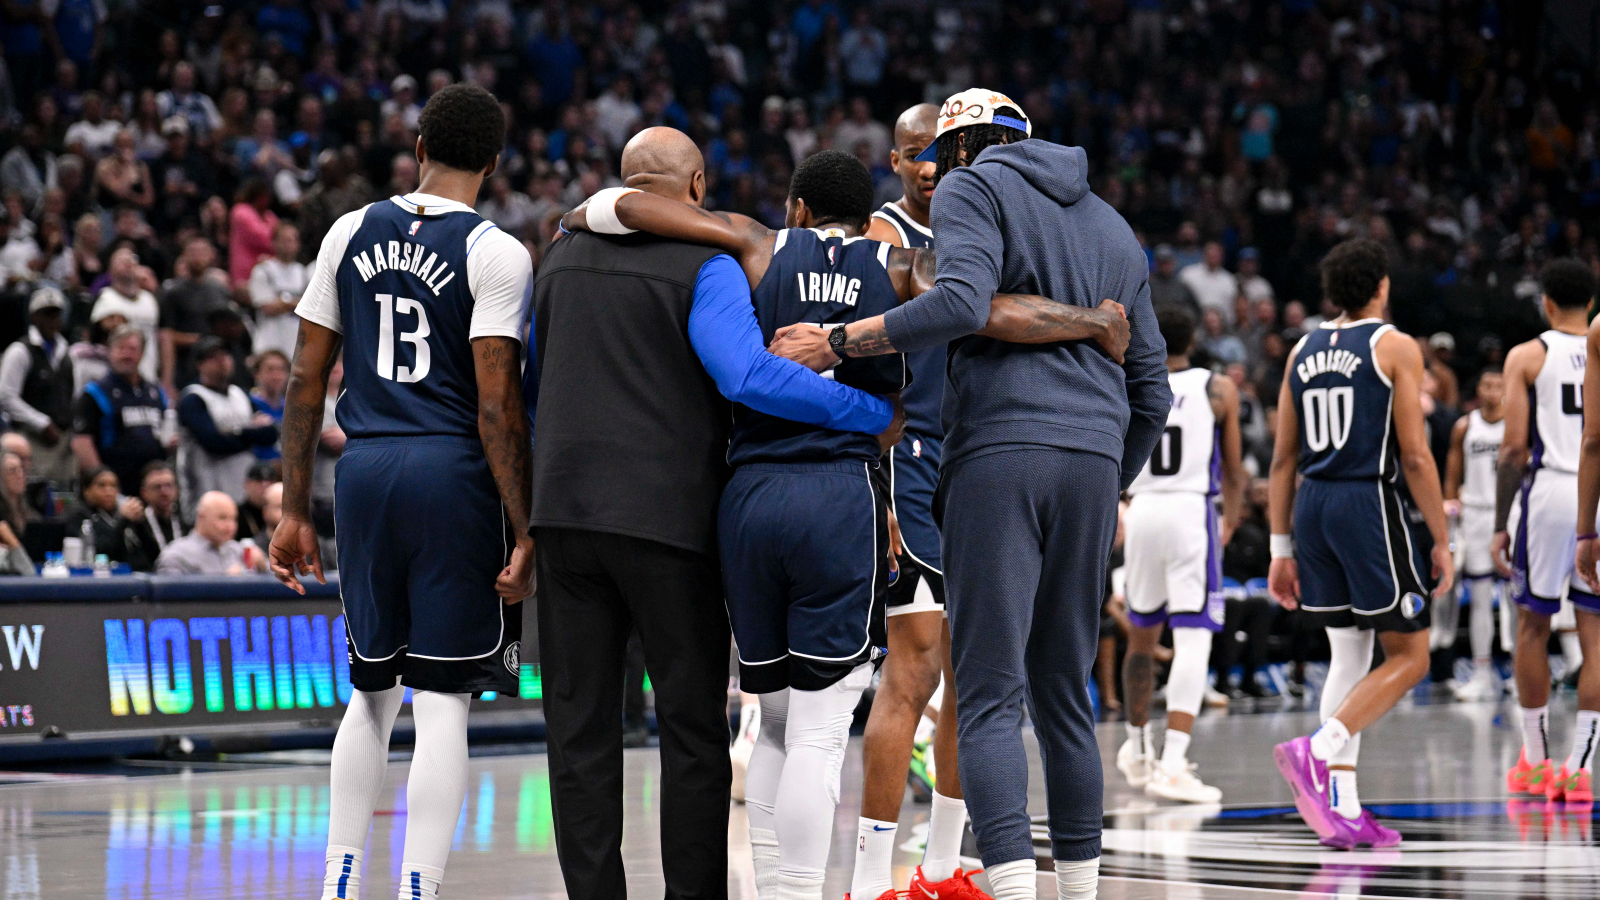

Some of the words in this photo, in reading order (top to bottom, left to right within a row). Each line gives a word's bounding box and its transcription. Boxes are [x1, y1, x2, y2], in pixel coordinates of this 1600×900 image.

[352, 240, 456, 297] MARSHALL
[797, 271, 862, 307] IRVNG
[374, 293, 431, 384] 13
[1297, 348, 1363, 384] CHRISTIE
[1302, 386, 1354, 453] 00
